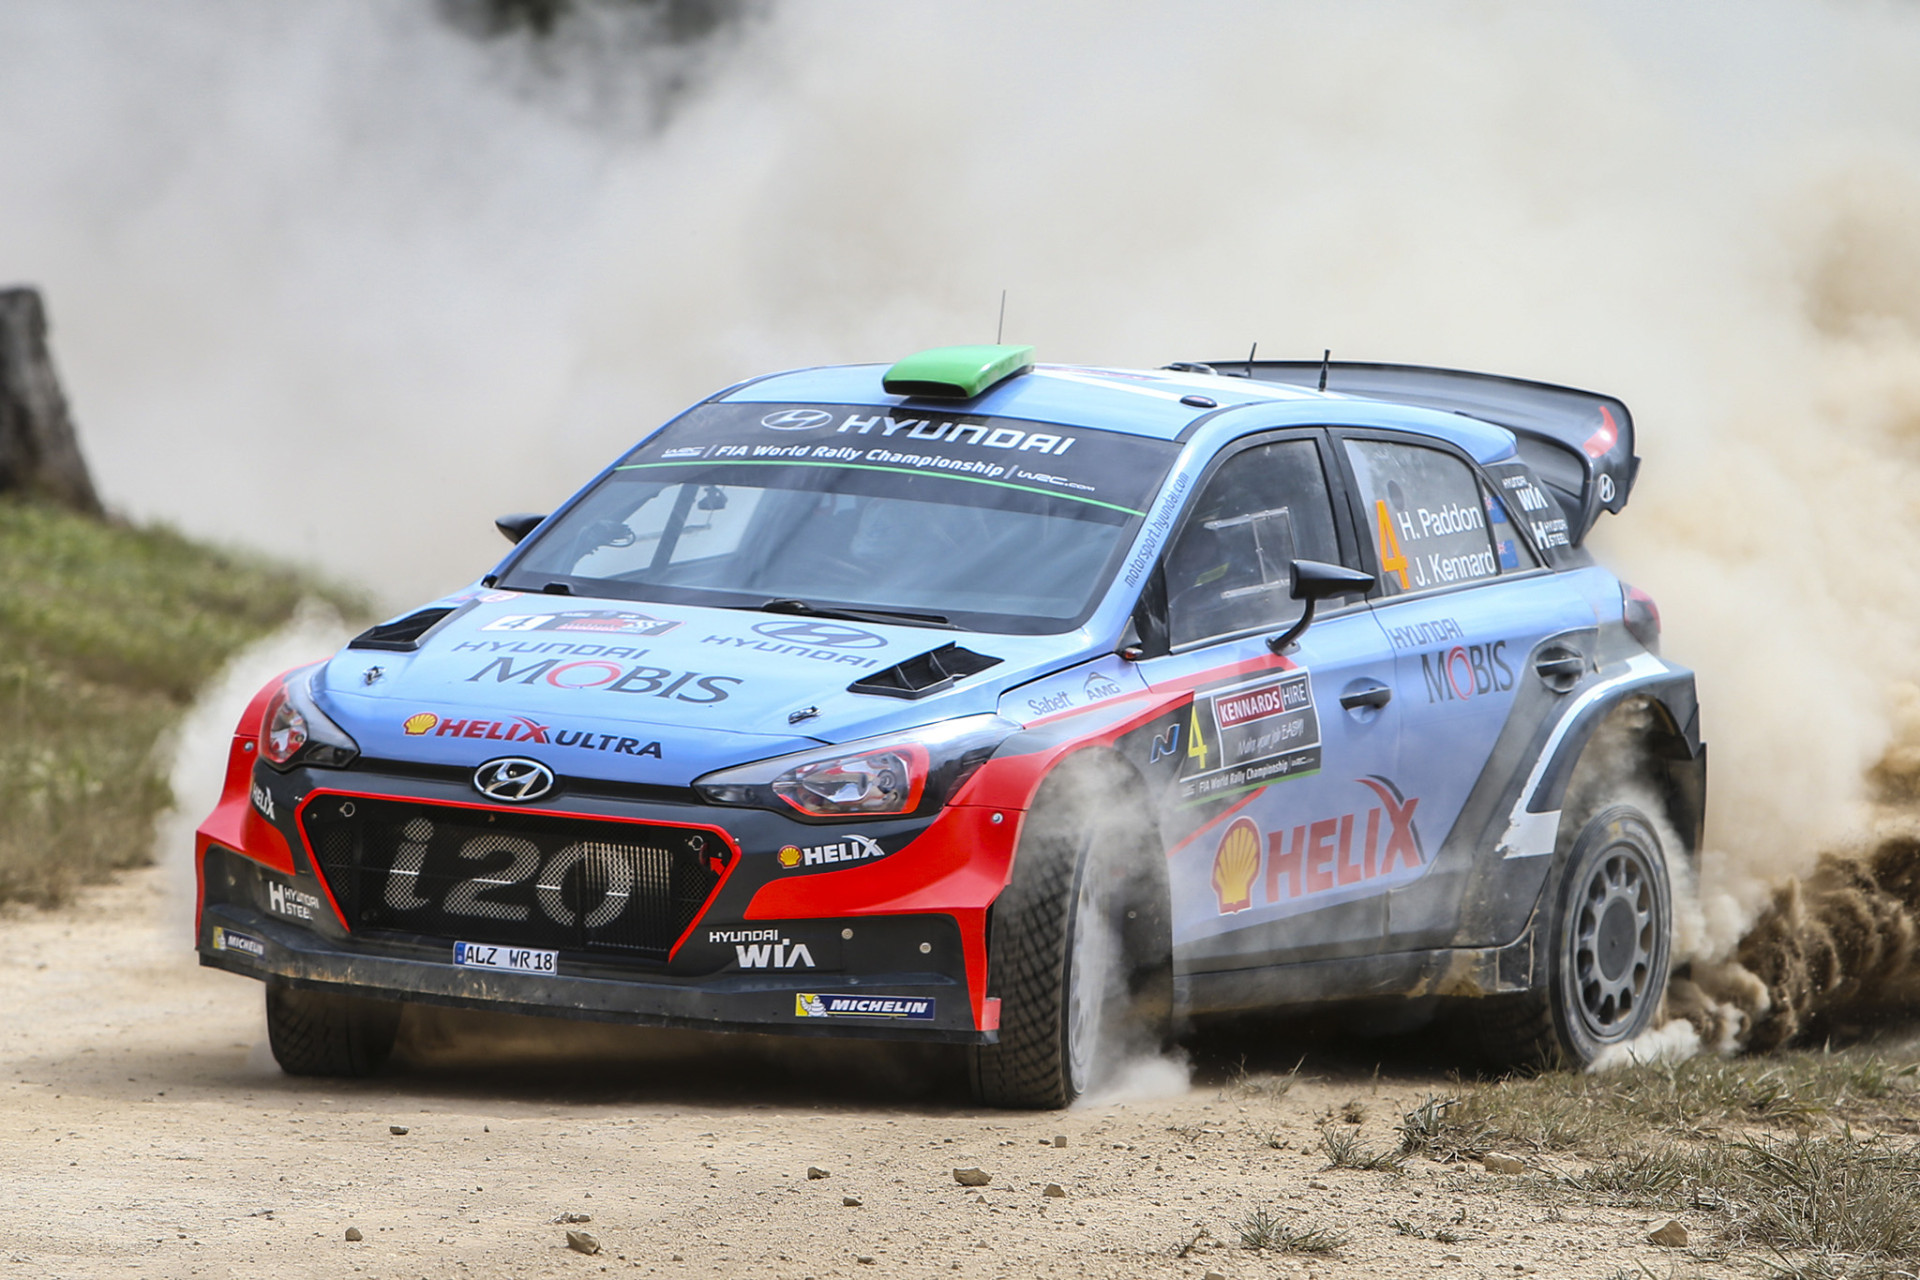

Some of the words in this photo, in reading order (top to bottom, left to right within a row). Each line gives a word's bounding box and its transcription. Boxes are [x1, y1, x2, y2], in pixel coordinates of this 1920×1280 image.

[837, 415, 1076, 455] HYUNDAI
[715, 446, 748, 457] FIA
[752, 445, 807, 457] World
[811, 445, 864, 461] Rally
[865, 449, 1005, 478] Championship
[1124, 471, 1189, 588] motorsport.hyundai.com
[1397, 512, 1420, 541] H.
[1418, 503, 1484, 538] Paddon
[1376, 500, 1410, 589] 4
[1415, 556, 1431, 586] J.
[1432, 544, 1497, 585] Kennard
[499, 616, 537, 629] 4
[1387, 617, 1464, 648] HYUNDAI
[451, 641, 651, 660] HYUNDAI
[701, 635, 878, 668] HYUNDAI
[464, 656, 744, 704] MOBIS
[1420, 640, 1515, 703] MOBIS
[1027, 690, 1074, 715] Sabelt
[1086, 683, 1121, 700] AMG
[1220, 690, 1281, 723] KENNARDS
[1282, 683, 1307, 705] HIRE
[435, 705, 551, 744] HELIX
[555, 730, 663, 759] ULTRA
[1188, 705, 1208, 769] 4
[1199, 780, 1210, 794] FIA
[1211, 774, 1229, 790] World
[1246, 760, 1289, 781] Championship
[802, 834, 886, 866] HELIX
[1266, 774, 1427, 904] HELIX
[383, 817, 635, 929] i20
[284, 887, 320, 909] HYUNDAI
[227, 934, 264, 955] MICHELIN
[709, 928, 779, 943] HYUNDAI
[465, 945, 498, 966] ALZ
[735, 938, 816, 968] WIA
[829, 998, 929, 1015] MICHELIN
